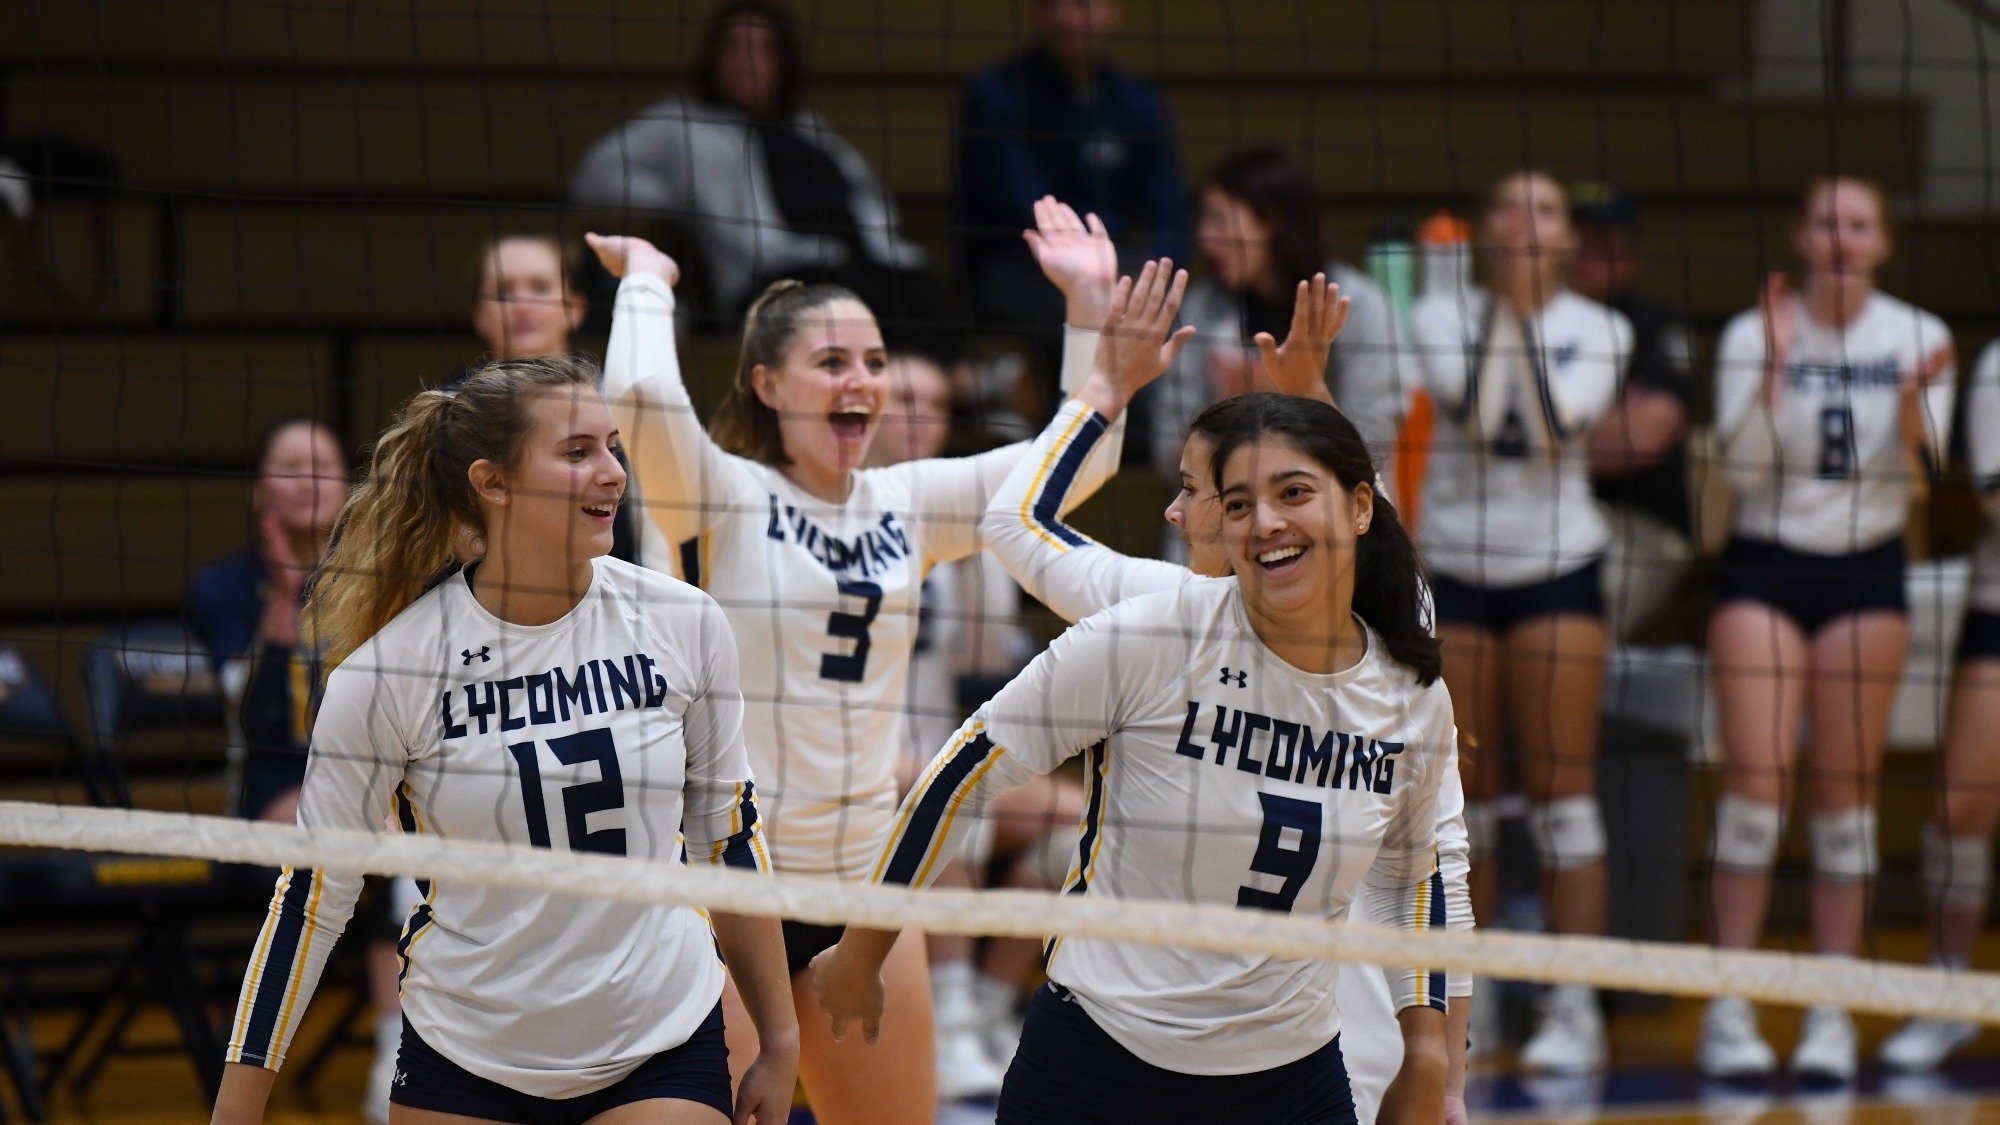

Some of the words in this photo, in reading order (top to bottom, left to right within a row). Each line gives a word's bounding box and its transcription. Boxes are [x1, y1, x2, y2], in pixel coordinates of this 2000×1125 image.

[819, 581, 883, 684] 3
[442, 653, 668, 740] LYCOMING
[1175, 700, 1405, 795] LYCOMING
[508, 726, 627, 857] 12
[1236, 791, 1323, 914] 9
